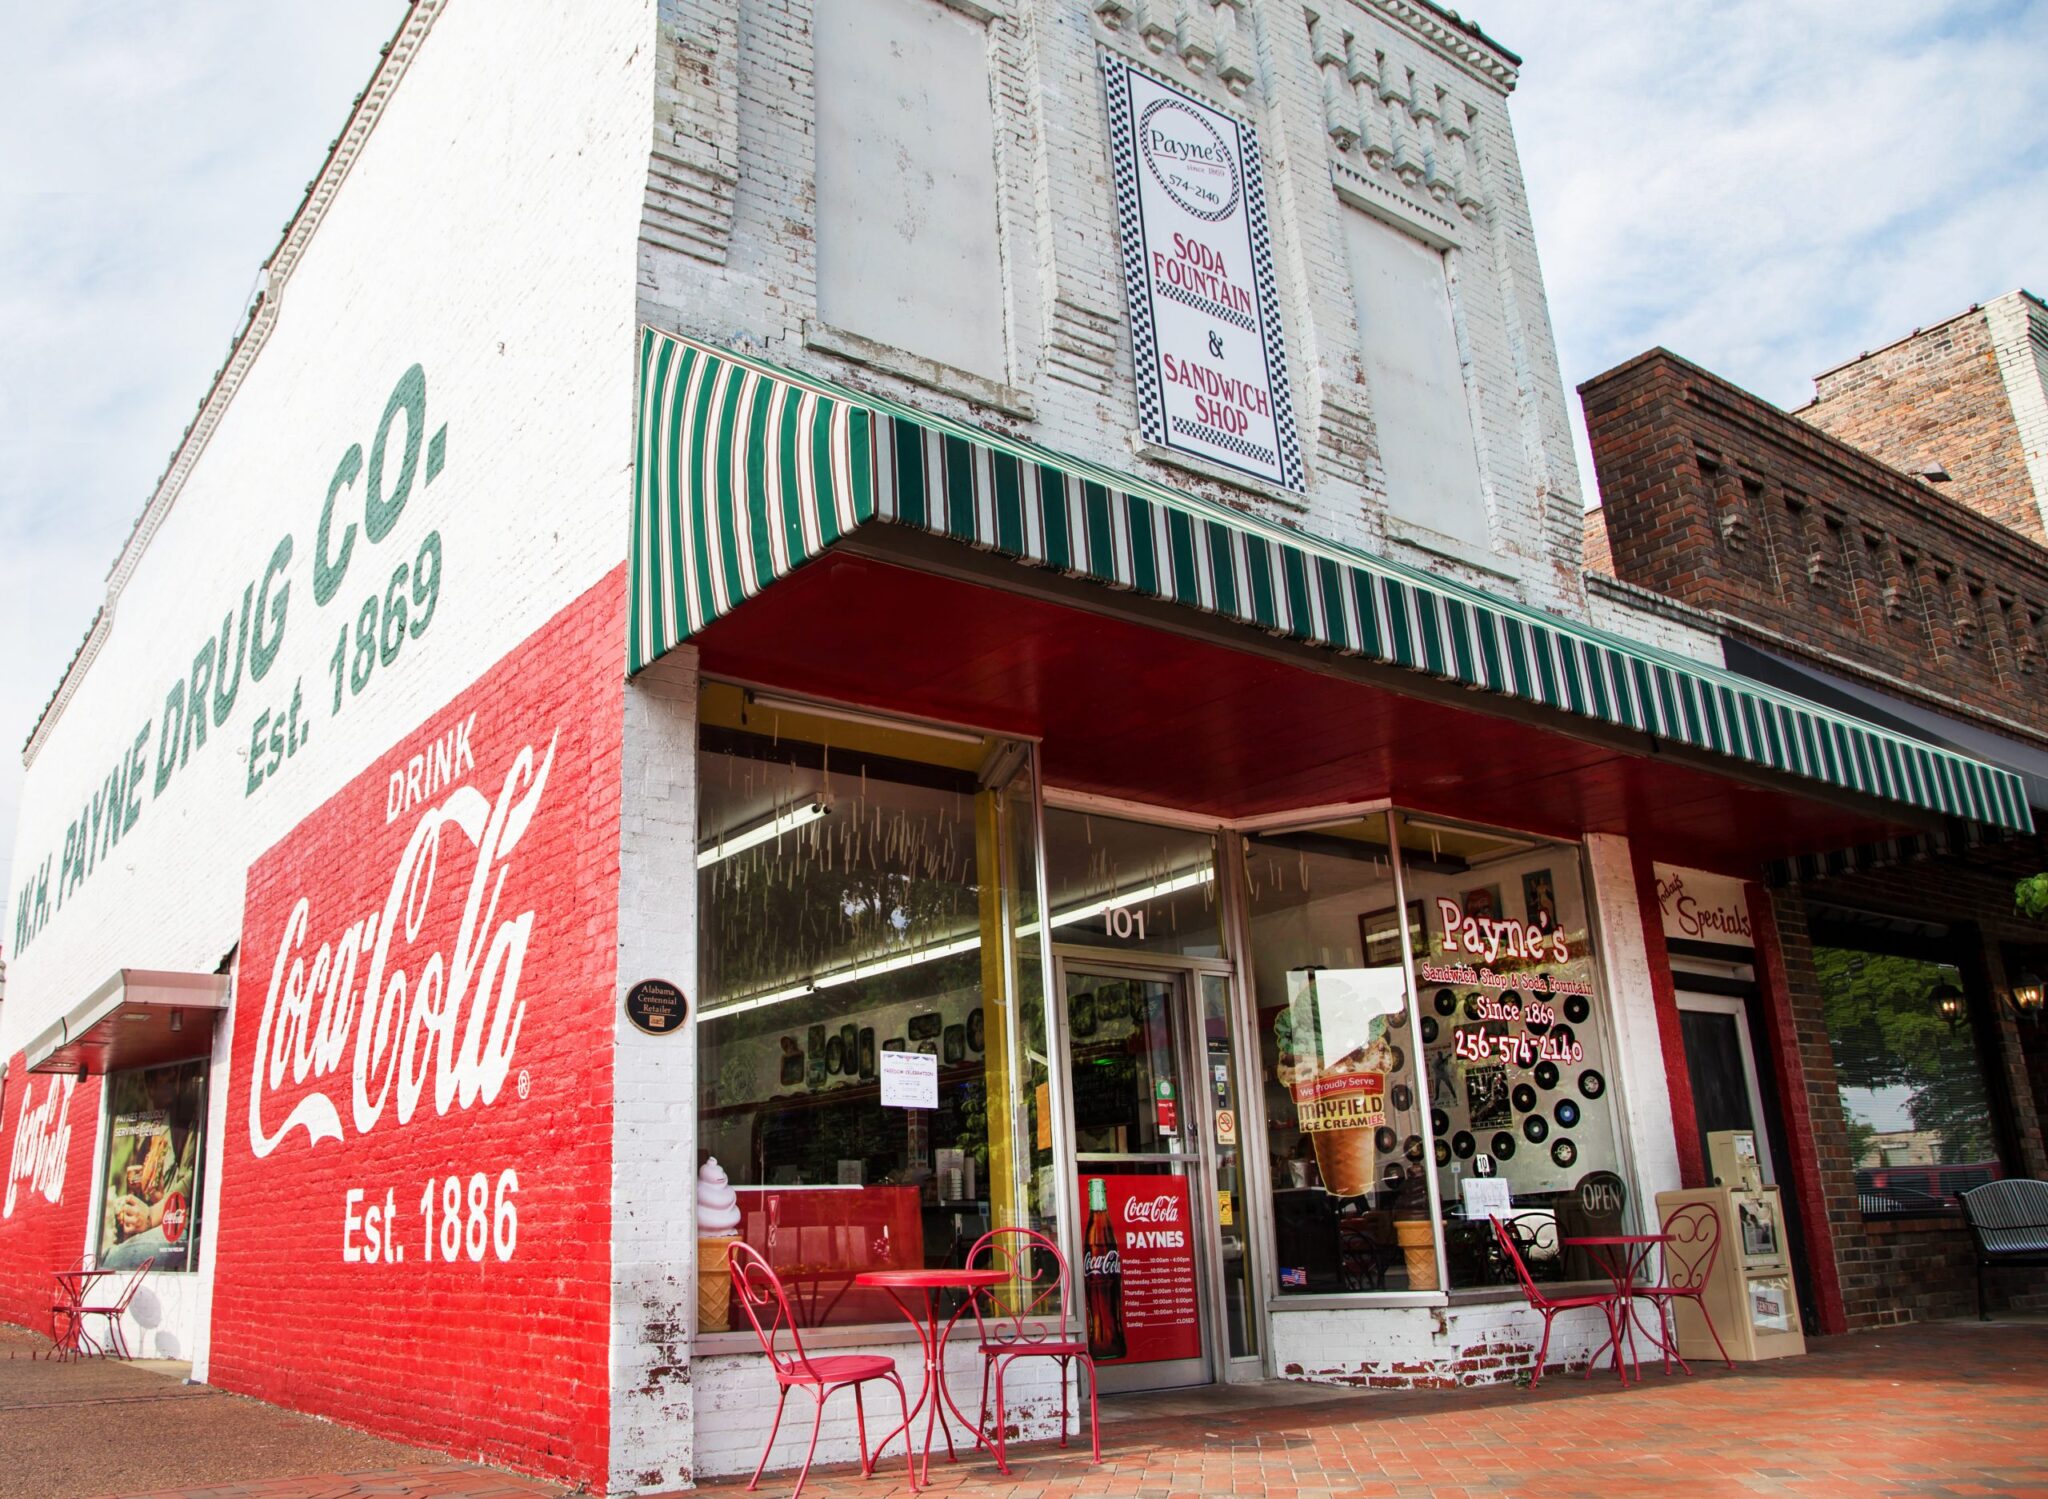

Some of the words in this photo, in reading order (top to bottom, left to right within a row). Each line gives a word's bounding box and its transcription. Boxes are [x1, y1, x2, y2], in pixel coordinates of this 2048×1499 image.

[1149, 129, 1225, 164] Payne's
[1168, 174, 1220, 205] 574-2140
[1173, 232, 1228, 278] SODA
[1152, 251, 1252, 316] FOUNTAIN
[1208, 330, 1224, 359] &
[1163, 353, 1270, 417] SANDWICH
[1194, 394, 1249, 436] SHOP
[13, 853, 52, 957] W.H.
[57, 718, 152, 912] PAYNE
[153, 533, 294, 800] DRUG
[312, 362, 448, 607] CO.
[245, 676, 309, 799] Est.
[329, 530, 442, 717] 1869
[386, 712, 476, 825] DRINK
[1100, 905, 1145, 940] 101
[1437, 897, 1569, 964] Payne's
[1676, 896, 1752, 939] Specials
[248, 726, 559, 1159] Coca-Cola
[641, 985, 675, 996] Alabama
[1421, 963, 1478, 985] Sandwich
[1481, 968, 1508, 989] Shop
[1511, 974, 1518, 988] &
[1521, 973, 1547, 991] Soda
[1548, 976, 1594, 997] Fountain
[637, 994, 677, 1005] Centennial
[643, 1004, 672, 1014] Retailer
[1477, 995, 1520, 1021] Since
[1524, 1003, 1555, 1026] 1869
[1455, 1026, 1583, 1064] 256-574-2140
[1300, 1087, 1313, 1097] We
[1316, 1078, 1347, 1094] Proudly
[1349, 1077, 1375, 1087] Serve
[1300, 1098, 1383, 1120] MAYFIELD
[1300, 1121, 1321, 1132] ICE
[1124, 1195, 1179, 1223] Coca-Cola
[1583, 1183, 1621, 1211] OPEN
[342, 1187, 404, 1264] Est.
[420, 1168, 519, 1263] 1886
[1126, 1231, 1185, 1249] PAYNES
